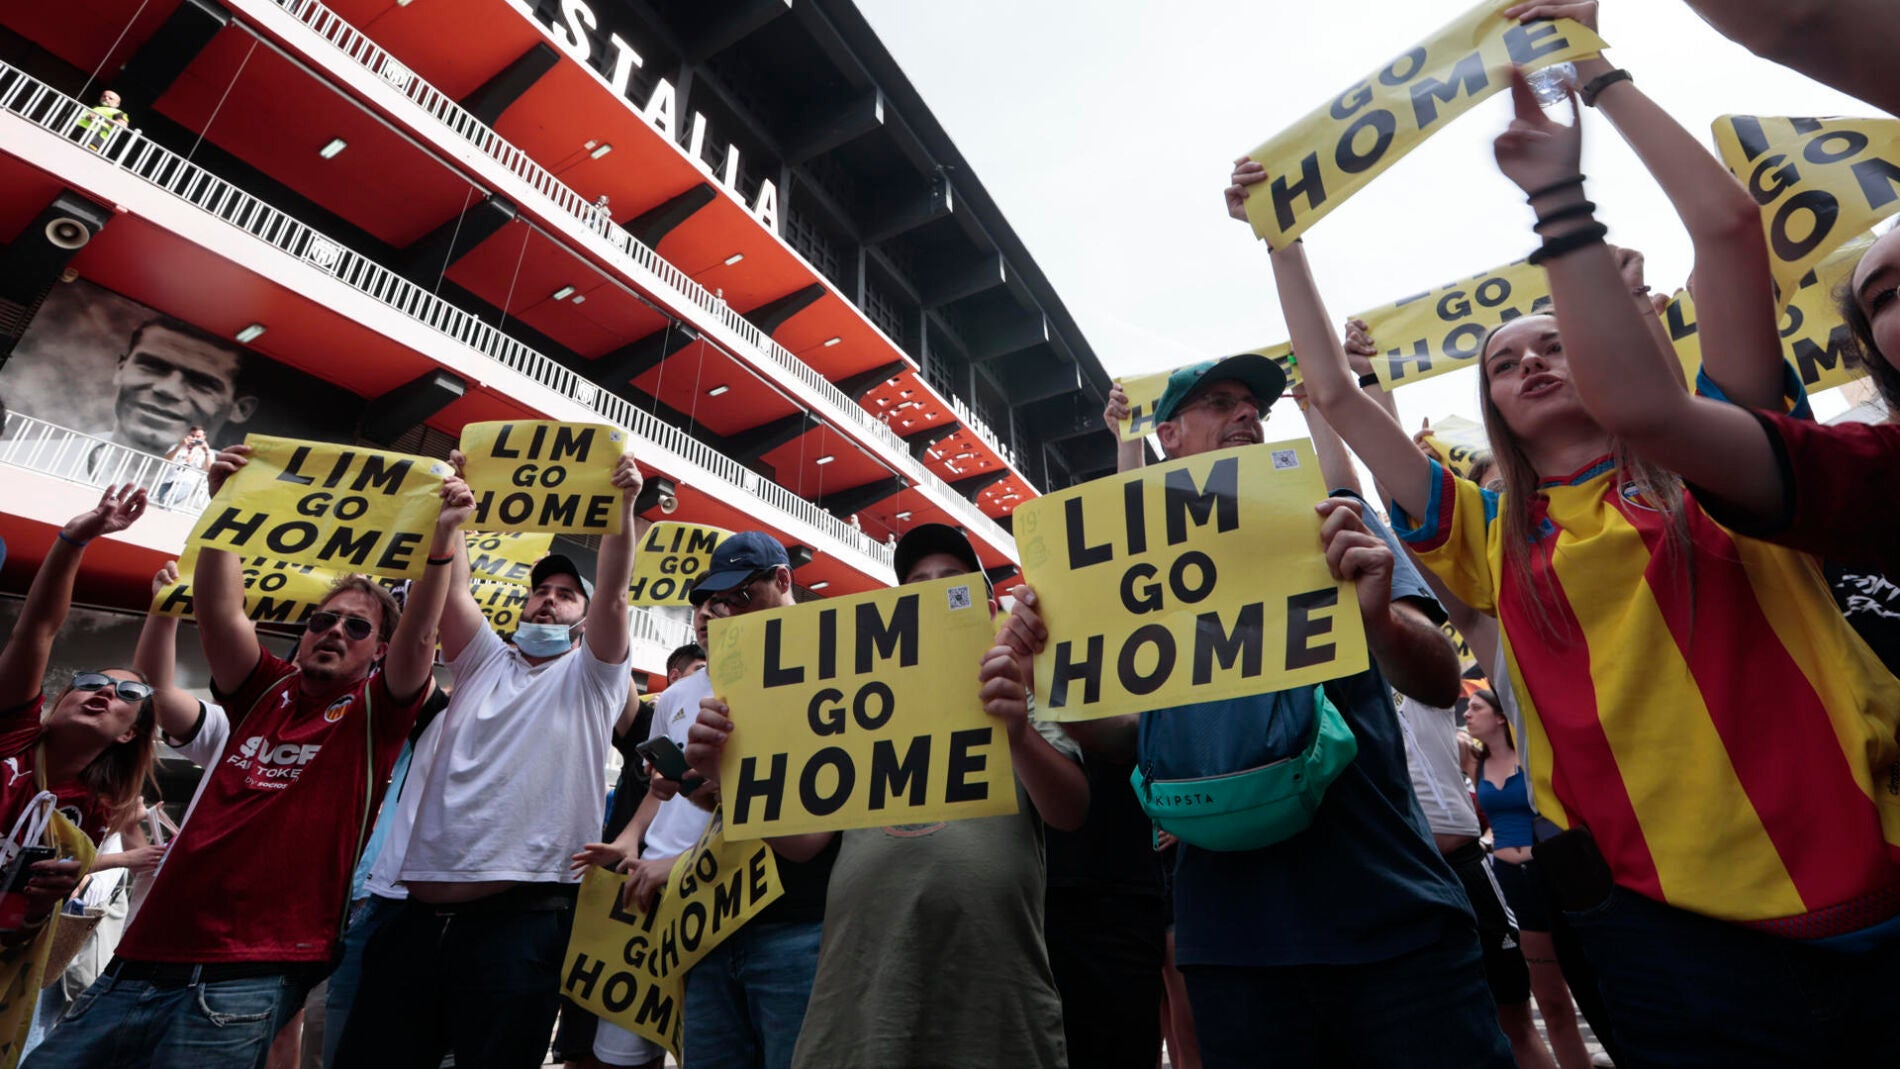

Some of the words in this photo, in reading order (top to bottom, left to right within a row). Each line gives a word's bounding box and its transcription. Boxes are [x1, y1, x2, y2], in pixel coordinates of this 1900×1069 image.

[1330, 46, 1427, 120] GO
[503, 0, 780, 239] STALLA
[1270, 16, 1570, 233] HOME
[1436, 277, 1512, 322] GO
[491, 425, 596, 462] LIM
[952, 393, 1000, 458] VALENCIA
[277, 446, 414, 495] LIM
[512, 464, 566, 487] GO
[297, 492, 369, 520] GO
[471, 490, 615, 528] HOME
[1065, 457, 1239, 570] LIM
[201, 507, 424, 570] HOME
[645, 527, 718, 554] LIM
[660, 556, 700, 575] GO
[1120, 551, 1217, 614] GO
[763, 594, 919, 688] LIM
[1049, 587, 1339, 708] HOME
[808, 681, 895, 737] GO
[733, 727, 993, 825] HOME
[1155, 793, 1214, 807] KIPSTA
[679, 848, 718, 899] GO
[661, 846, 768, 979] HOME
